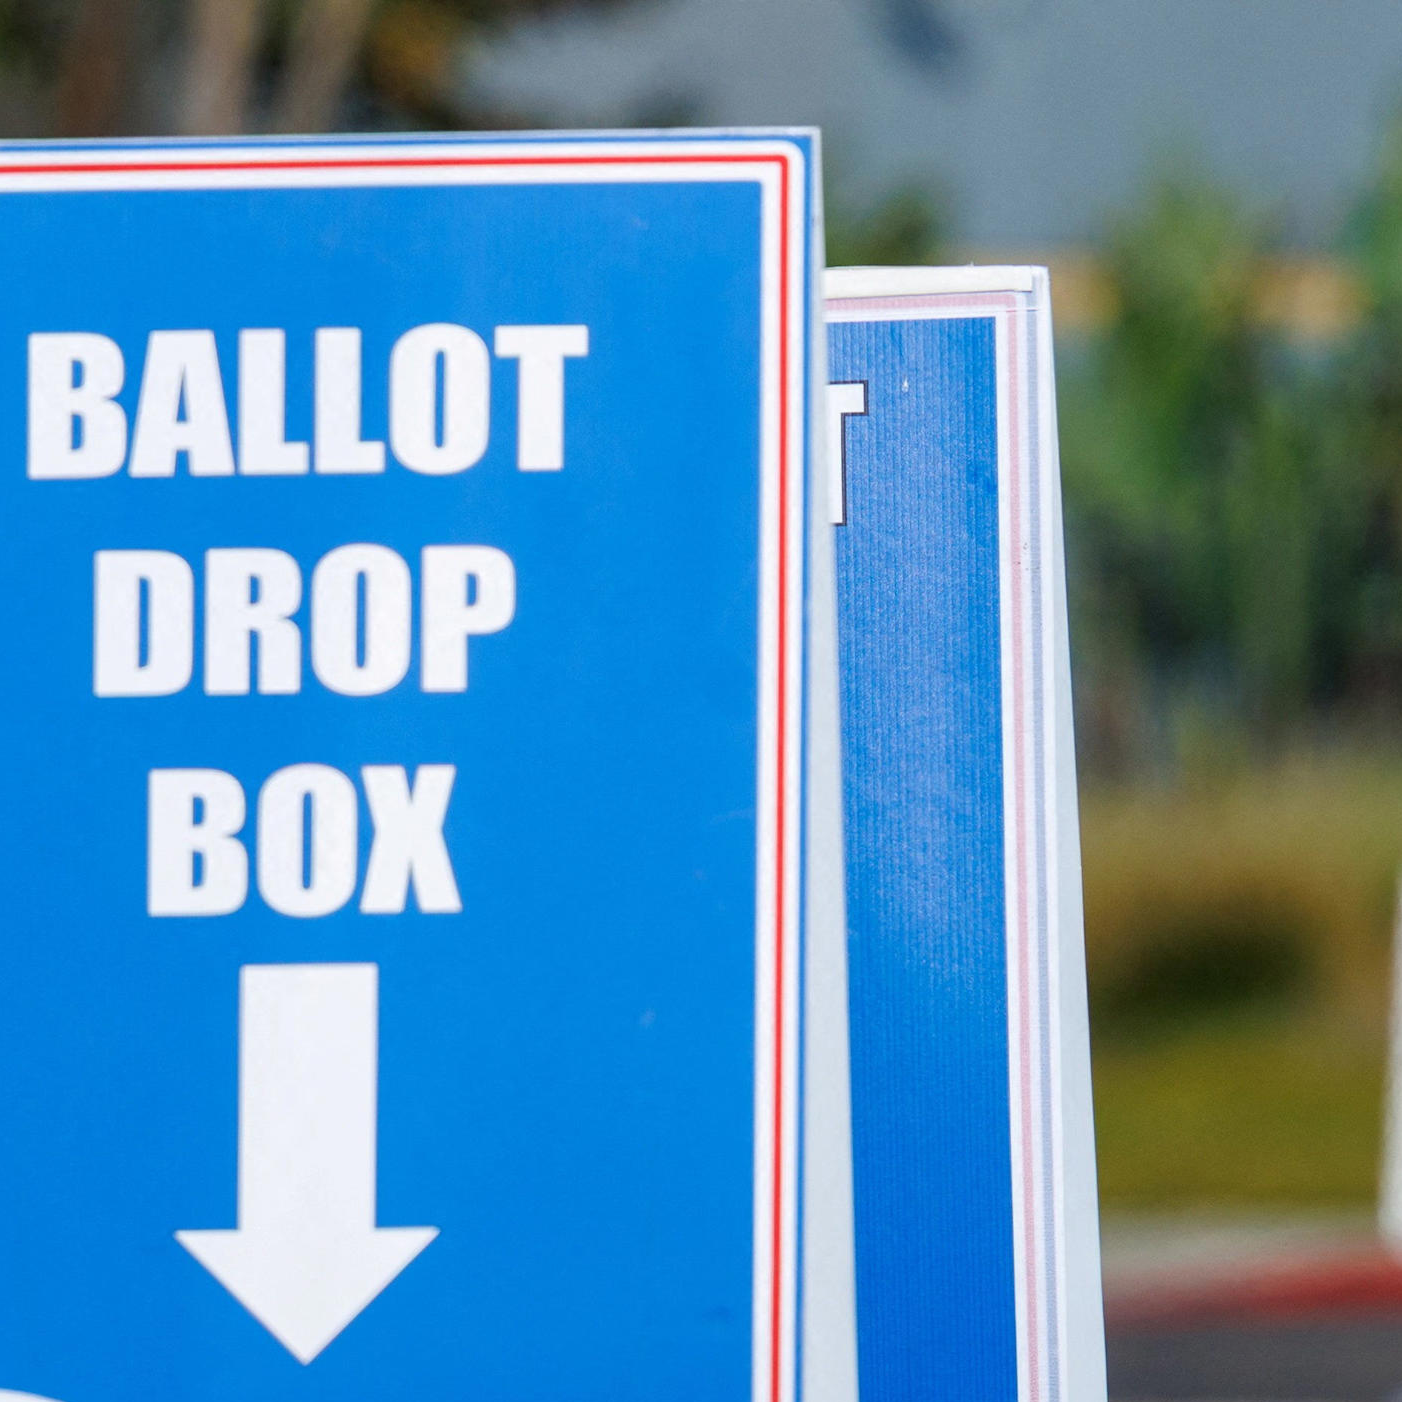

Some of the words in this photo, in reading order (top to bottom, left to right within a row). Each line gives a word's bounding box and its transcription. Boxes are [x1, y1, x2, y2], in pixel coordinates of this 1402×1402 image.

[26, 322, 590, 481] BALLOT
[93, 542, 517, 698] DROP
[147, 762, 463, 918] BOX
